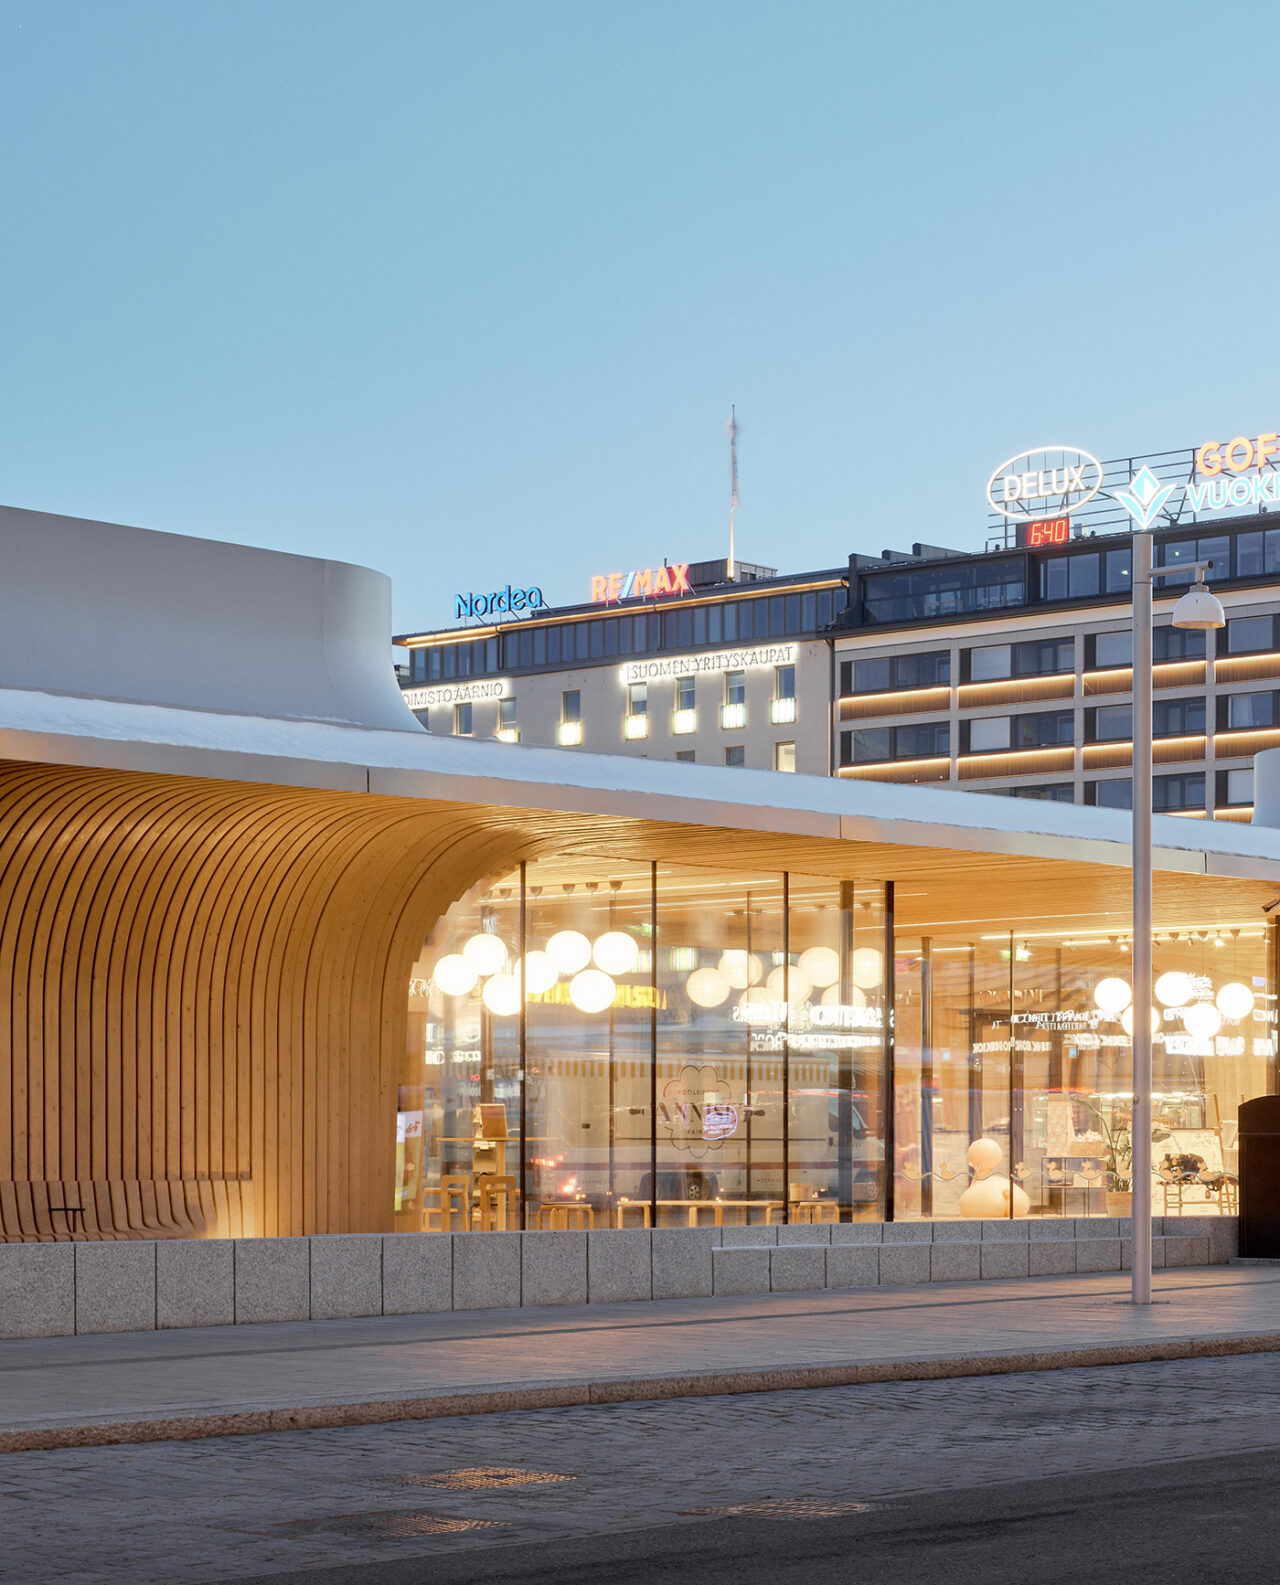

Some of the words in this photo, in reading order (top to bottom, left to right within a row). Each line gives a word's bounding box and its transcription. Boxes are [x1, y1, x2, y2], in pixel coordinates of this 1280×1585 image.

[1003, 465, 1087, 502] DELUX
[591, 564, 690, 602] RE/MAX
[454, 584, 543, 619] Nordea
[631, 660, 690, 680] SUOMEN
[690, 646, 793, 672] YRITYSKAUPAT
[455, 682, 503, 701] AARNIO
